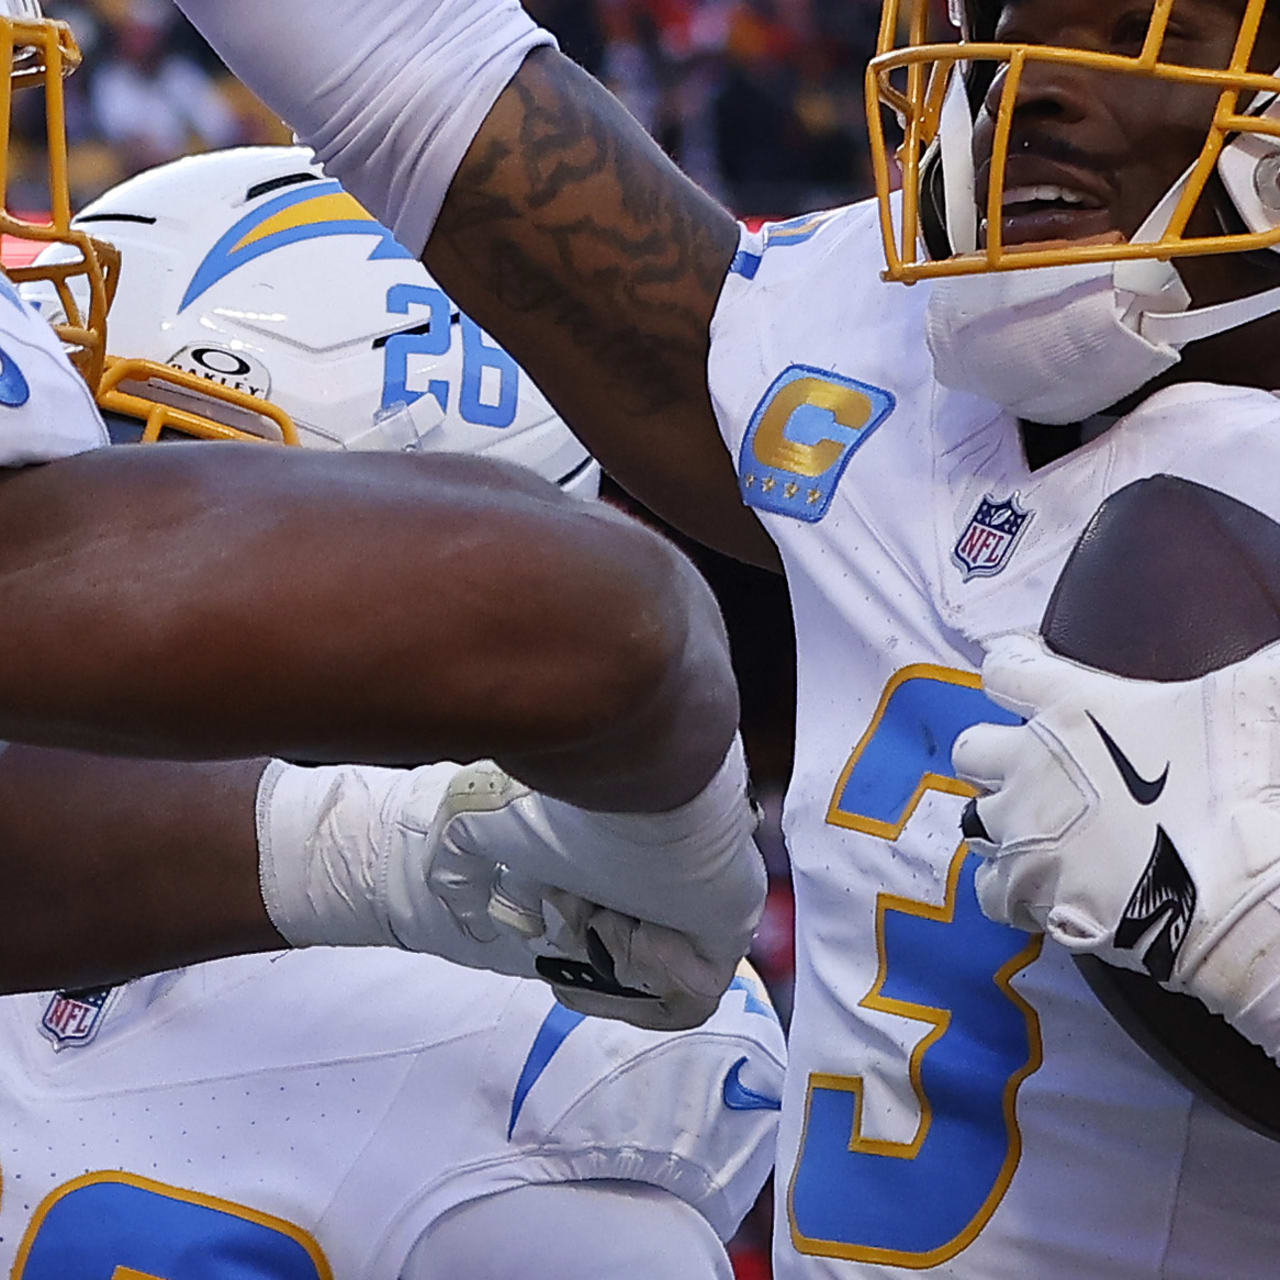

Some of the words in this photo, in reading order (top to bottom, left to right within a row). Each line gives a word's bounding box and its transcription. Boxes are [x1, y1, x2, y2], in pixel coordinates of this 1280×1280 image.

[380, 283, 519, 428] 26
[753, 377, 872, 477] C
[960, 525, 1005, 564] NFL
[787, 662, 1044, 1270] 3
[48, 999, 91, 1035] NFL
